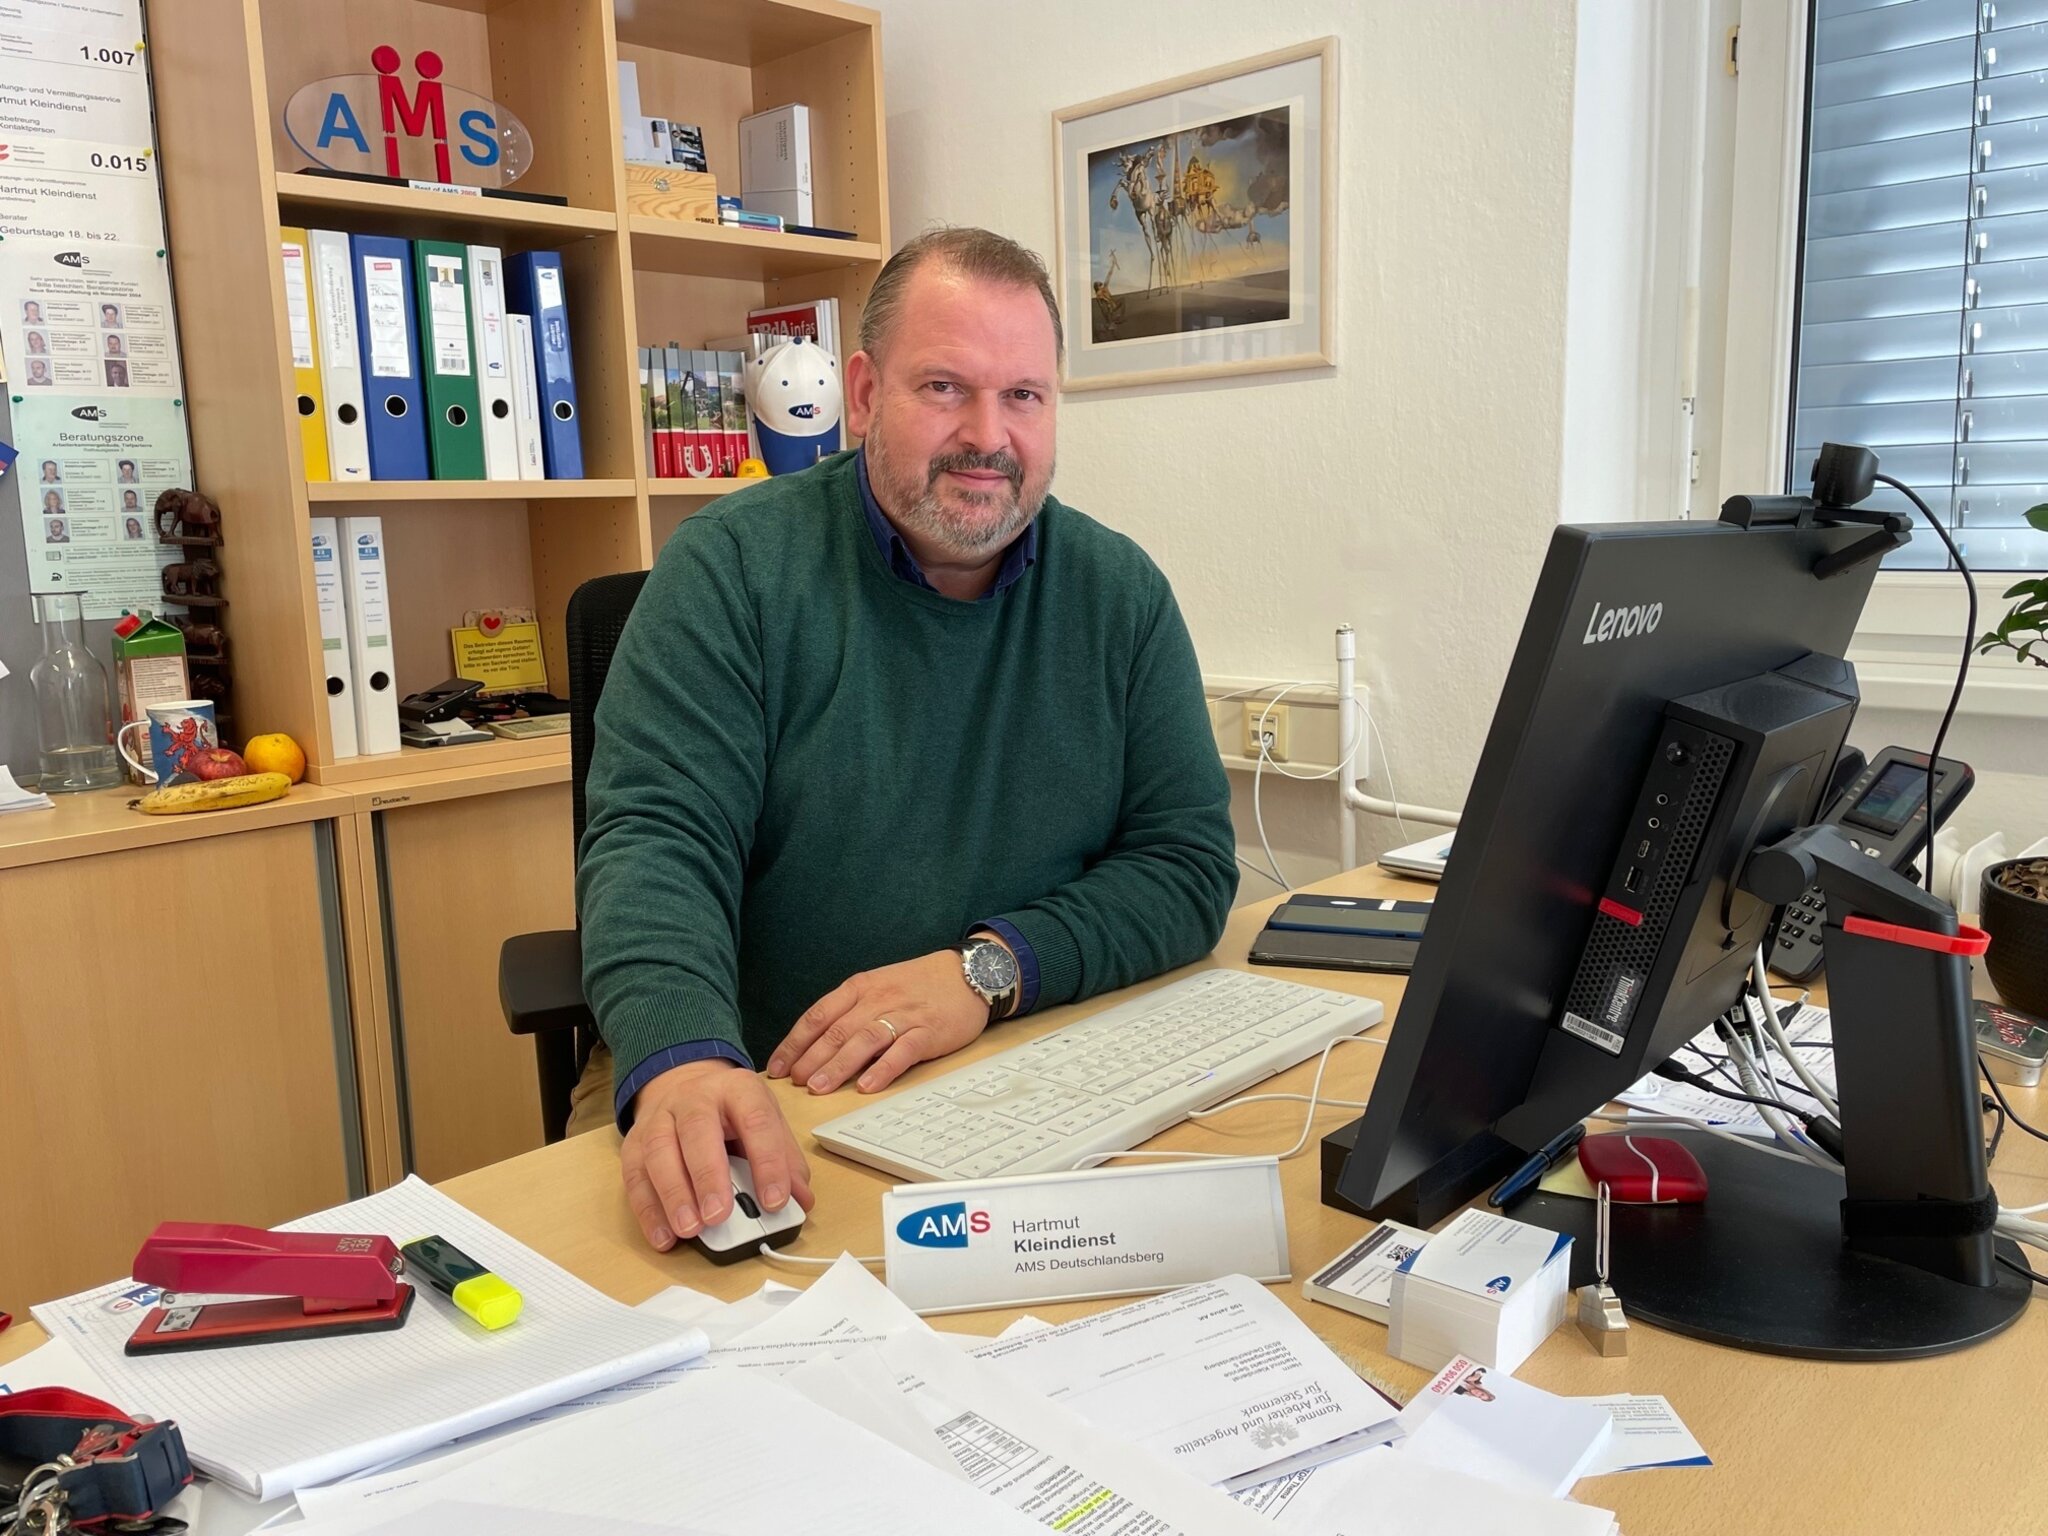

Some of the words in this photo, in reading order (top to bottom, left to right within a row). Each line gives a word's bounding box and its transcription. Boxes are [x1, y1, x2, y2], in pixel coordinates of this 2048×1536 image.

[80, 46, 135, 66] 1.007
[30, 98, 87, 112] Kleindienst
[46, 89, 121, 103] Vermittlungsservice
[91, 153, 147, 172] 0.015
[40, 187, 97, 200] Kleindienst
[0, 225, 65, 238] Geburtstage
[69, 230, 84, 239] 18.
[87, 231, 101, 240] bis
[104, 232, 120, 242] 22.
[62, 255, 90, 264] AMS
[80, 409, 107, 418] AMS
[795, 405, 821, 416] AMS
[59, 432, 144, 443] Beratungszone
[1582, 600, 1664, 645] Lenovo
[1606, 975, 1635, 1022] ThinkCentre
[918, 1211, 991, 1240] AMS
[1012, 1216, 1080, 1234] Hartmut
[1013, 1232, 1117, 1254] Kleindienst
[1014, 1259, 1046, 1274] AMS
[1050, 1250, 1165, 1272] Deutschlandsberg
[1304, 1381, 1322, 1394] für
[1240, 1390, 1303, 1416] Steiermark
[1315, 1390, 1333, 1404] für
[1268, 1400, 1312, 1421] Arbeiter
[1294, 1402, 1342, 1425] Kammer
[1243, 1416, 1264, 1432] und
[1173, 1425, 1240, 1455] Angestellte
